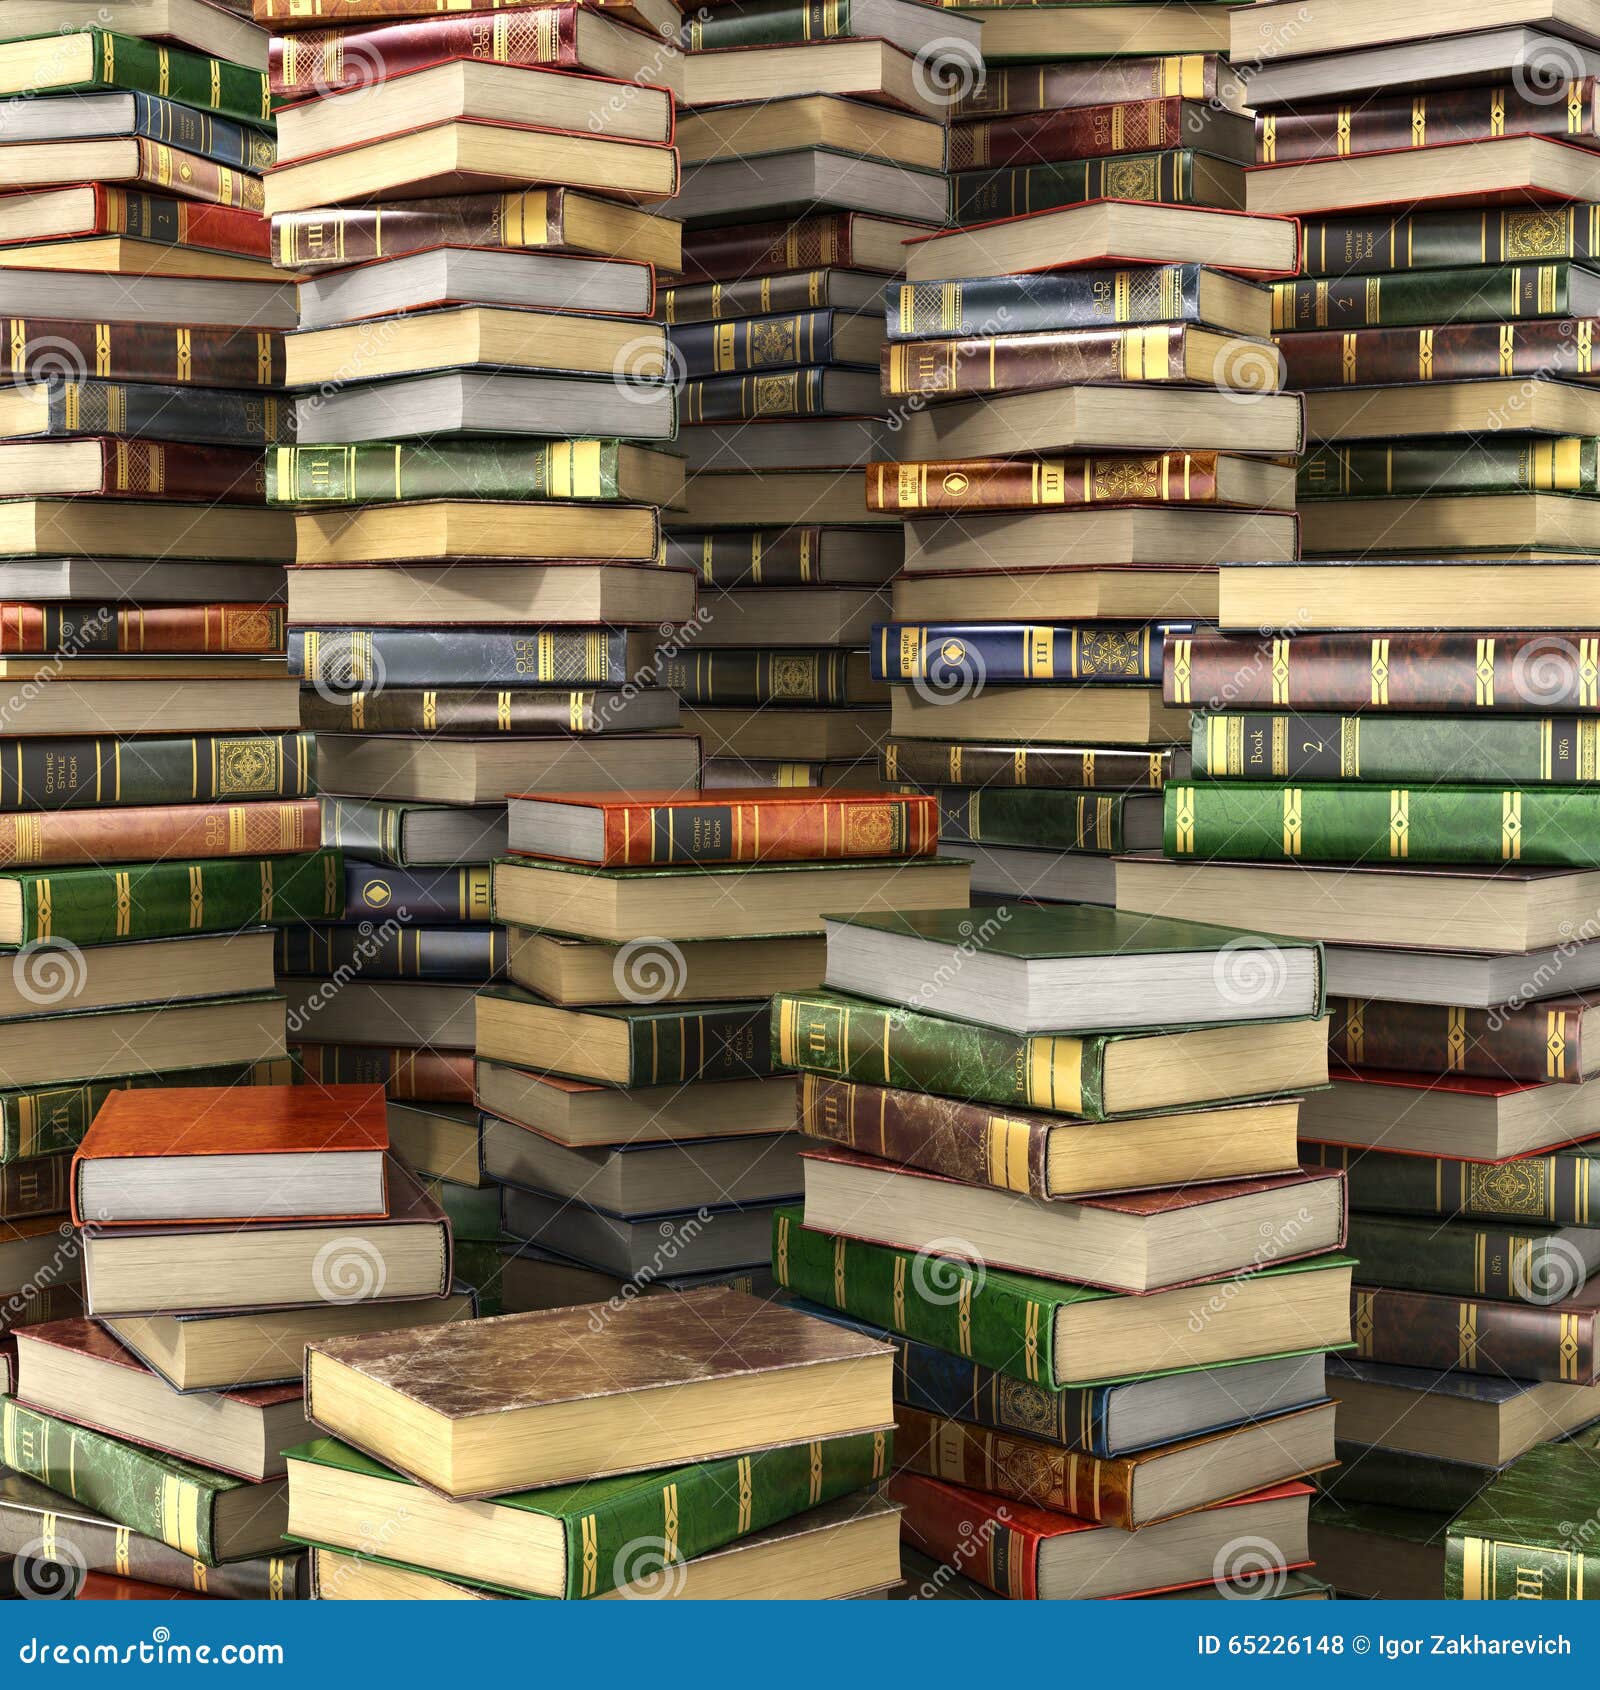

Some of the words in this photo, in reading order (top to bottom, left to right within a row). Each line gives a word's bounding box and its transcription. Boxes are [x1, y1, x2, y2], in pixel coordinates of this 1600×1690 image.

[472, 24, 482, 57] OLD
[482, 24, 490, 57] BOOK
[129, 198, 139, 228] Book
[158, 215, 169, 224] 2
[307, 225, 323, 247] III
[1345, 230, 1354, 263] GOTHIC
[1355, 232, 1363, 260] STYLE
[1365, 231, 1374, 258] BOOK
[1094, 281, 1104, 316] OLD
[1103, 281, 1112, 315] BOOK
[1300, 291, 1310, 319] Book
[1337, 298, 1354, 307] 2
[1525, 282, 1533, 299] 1876
[918, 356, 935, 378] III
[1110, 340, 1119, 373] BOOK
[312, 461, 329, 485] III
[535, 453, 543, 489] BOOK
[1046, 472, 1059, 492] III
[1308, 460, 1327, 481] III
[516, 639, 527, 674] OLD
[526, 641, 534, 673] BOOK
[902, 634, 910, 655] style
[1036, 641, 1048, 664] III
[902, 657, 910, 670] old
[1250, 729, 1264, 765] Book
[1303, 741, 1323, 753] 2
[1558, 738, 1569, 761] 1876
[45, 752, 54, 795] GOTHIC
[57, 756, 66, 791] STYLE
[69, 756, 77, 788] BOOK
[205, 815, 216, 848] OLD
[216, 816, 225, 847] BOOK
[693, 817, 701, 853] GOTHIC
[703, 819, 711, 848] STYLE
[713, 819, 721, 848] BOOK
[475, 883, 487, 905] III
[809, 1022, 826, 1051] III
[1016, 1047, 1025, 1092] BOOK
[824, 1097, 838, 1124] III
[19, 1173, 38, 1200] III
[1491, 1255, 1500, 1276] 1876
[21, 1431, 33, 1460] III
[945, 1439, 959, 1466] III
